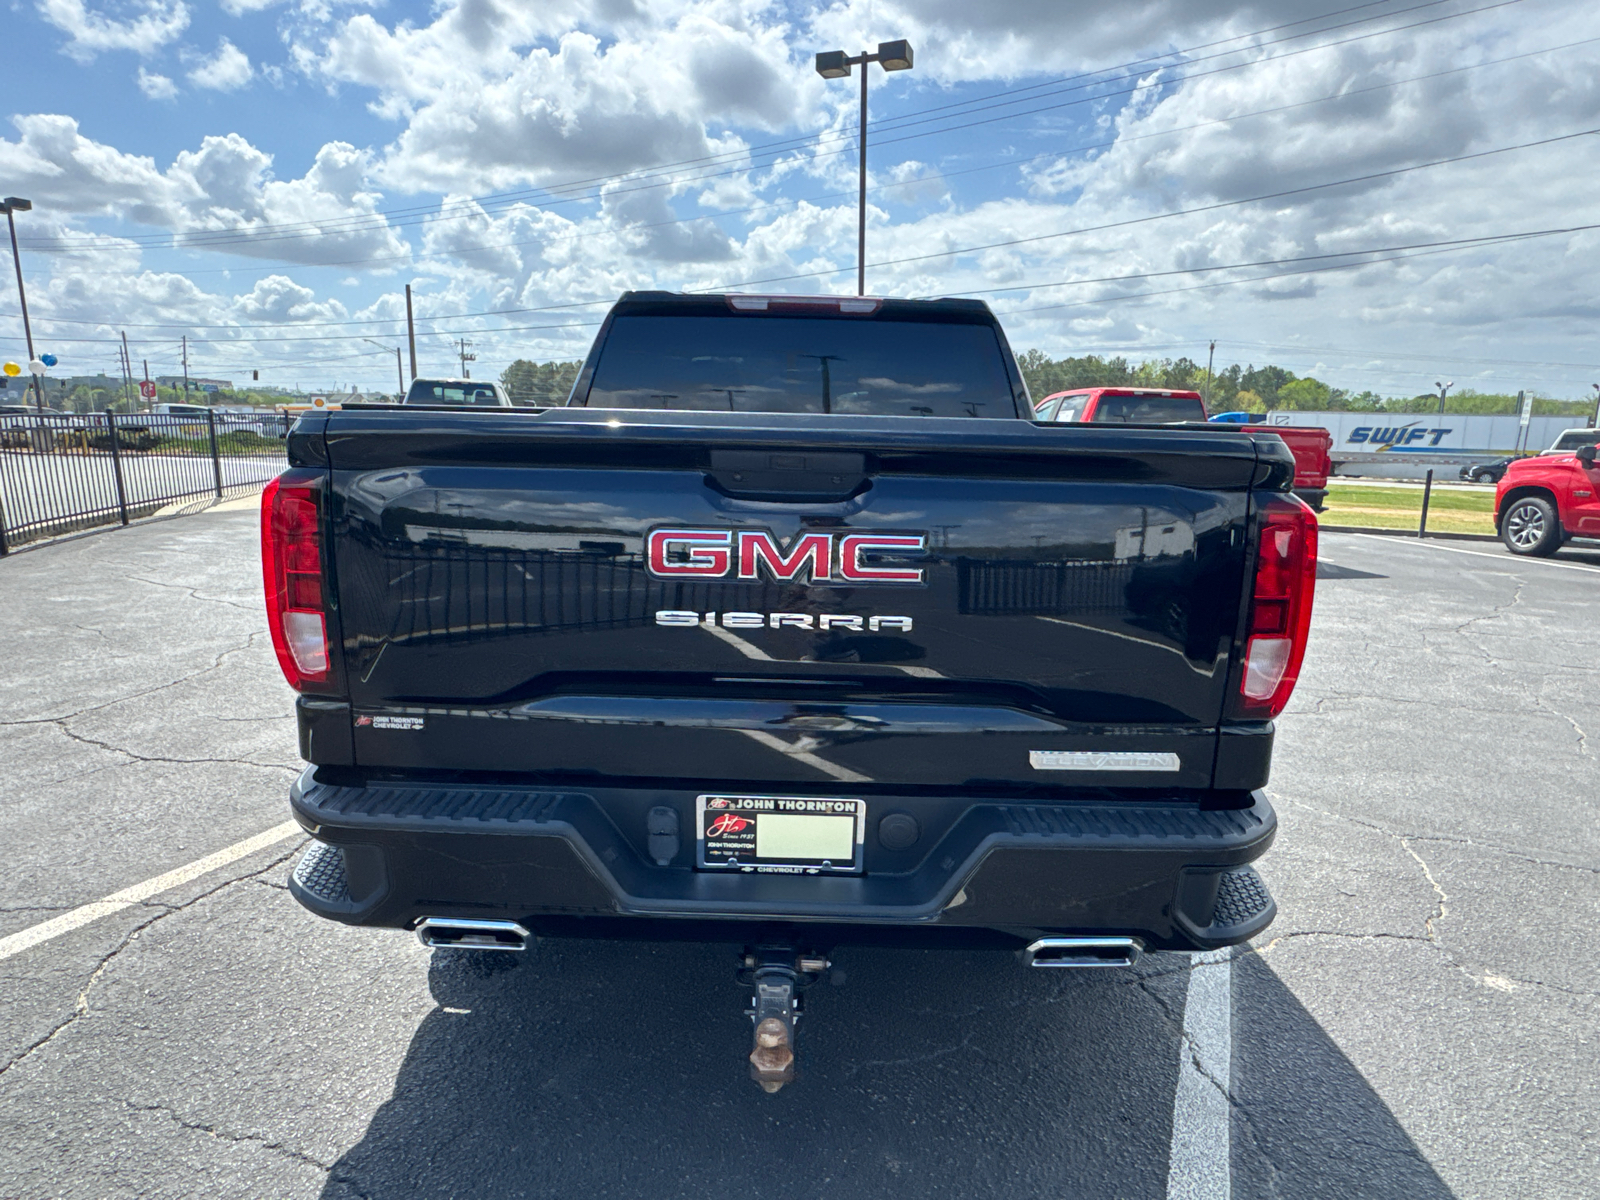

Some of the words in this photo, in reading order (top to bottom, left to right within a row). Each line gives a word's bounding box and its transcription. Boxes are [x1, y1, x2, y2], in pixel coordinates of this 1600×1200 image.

[1346, 426, 1452, 446] SWIFT
[648, 529, 924, 582] GMC
[655, 610, 913, 632] SIERRA
[373, 722, 411, 730] CHEVROLET
[1042, 754, 1169, 767] ELEVATION
[736, 799, 774, 810] JOHN
[778, 800, 855, 812] THORNTON
